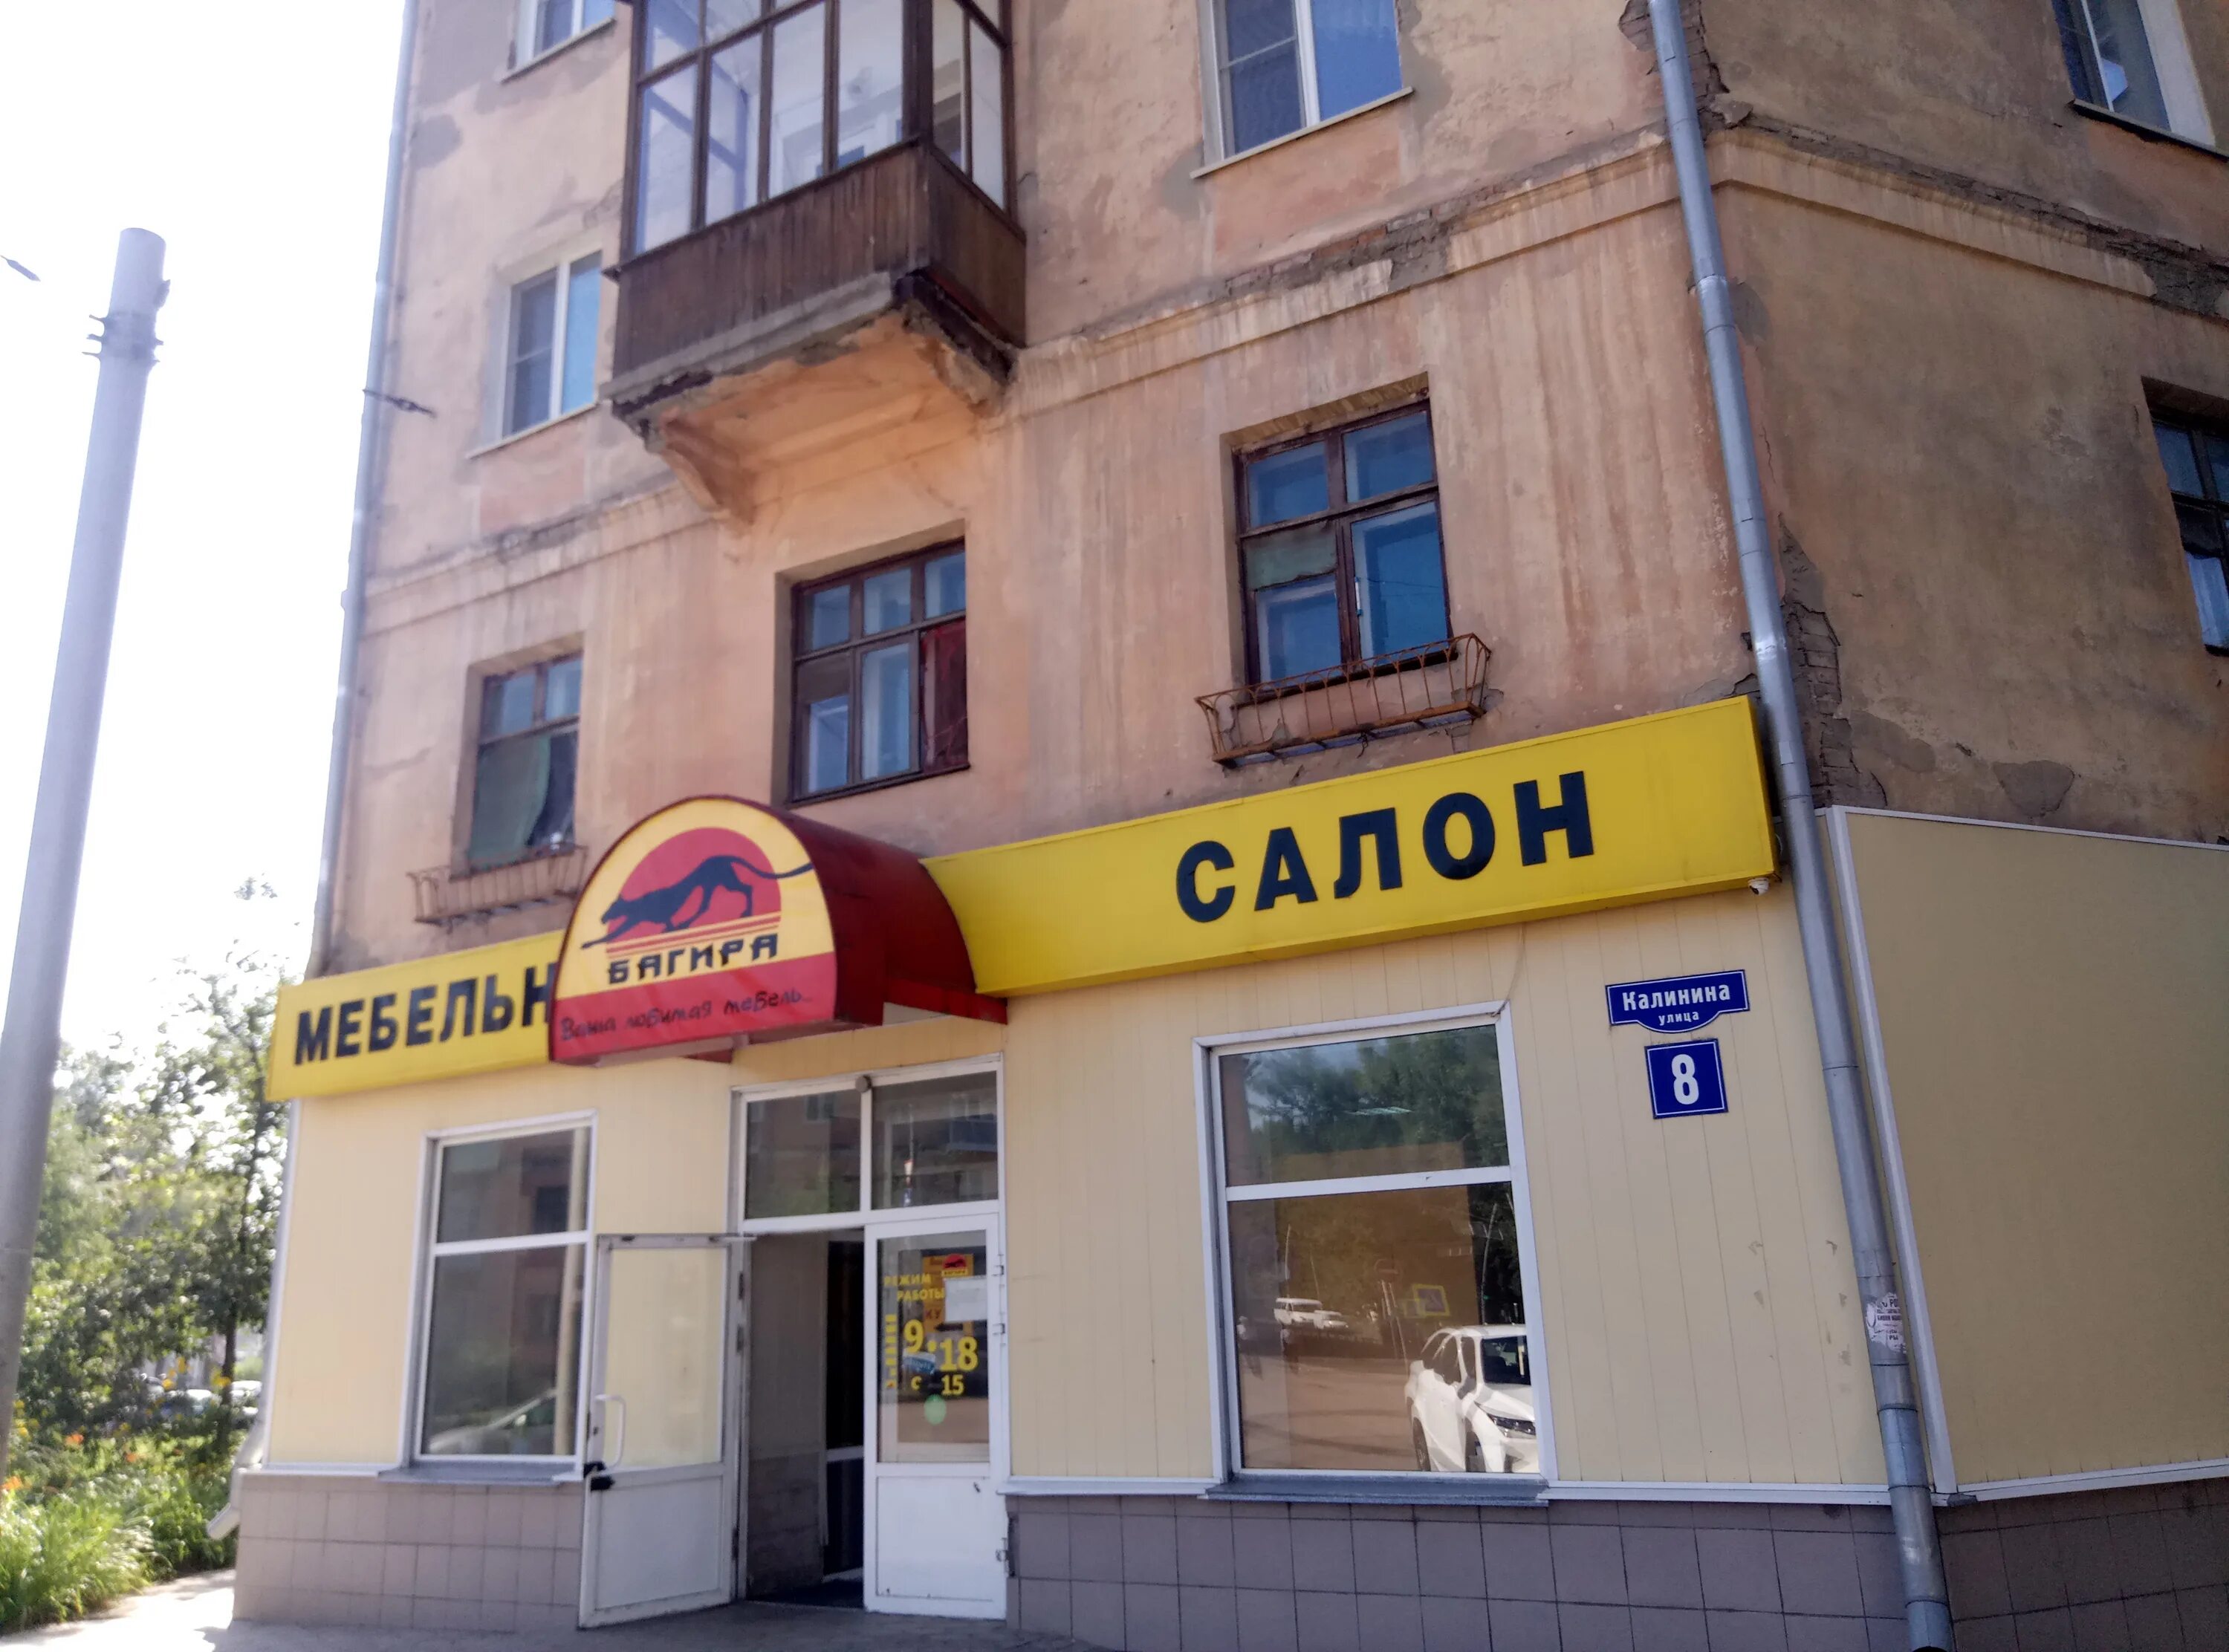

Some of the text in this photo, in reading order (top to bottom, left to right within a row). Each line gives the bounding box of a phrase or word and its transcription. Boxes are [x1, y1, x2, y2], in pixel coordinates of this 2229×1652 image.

[1175, 770, 1594, 923] САЛОН
[607, 933, 779, 984] БАГИРА
[1622, 984, 1730, 1011] Калинина
[293, 962, 557, 1065] МЕБЕЛЬН
[1658, 1011, 1699, 1026] улица
[560, 1015, 617, 1041] Ваша
[1672, 1053, 1699, 1105] 8
[897, 1287, 945, 1301] РАБОТЫ
[941, 1374, 964, 1396] 15
